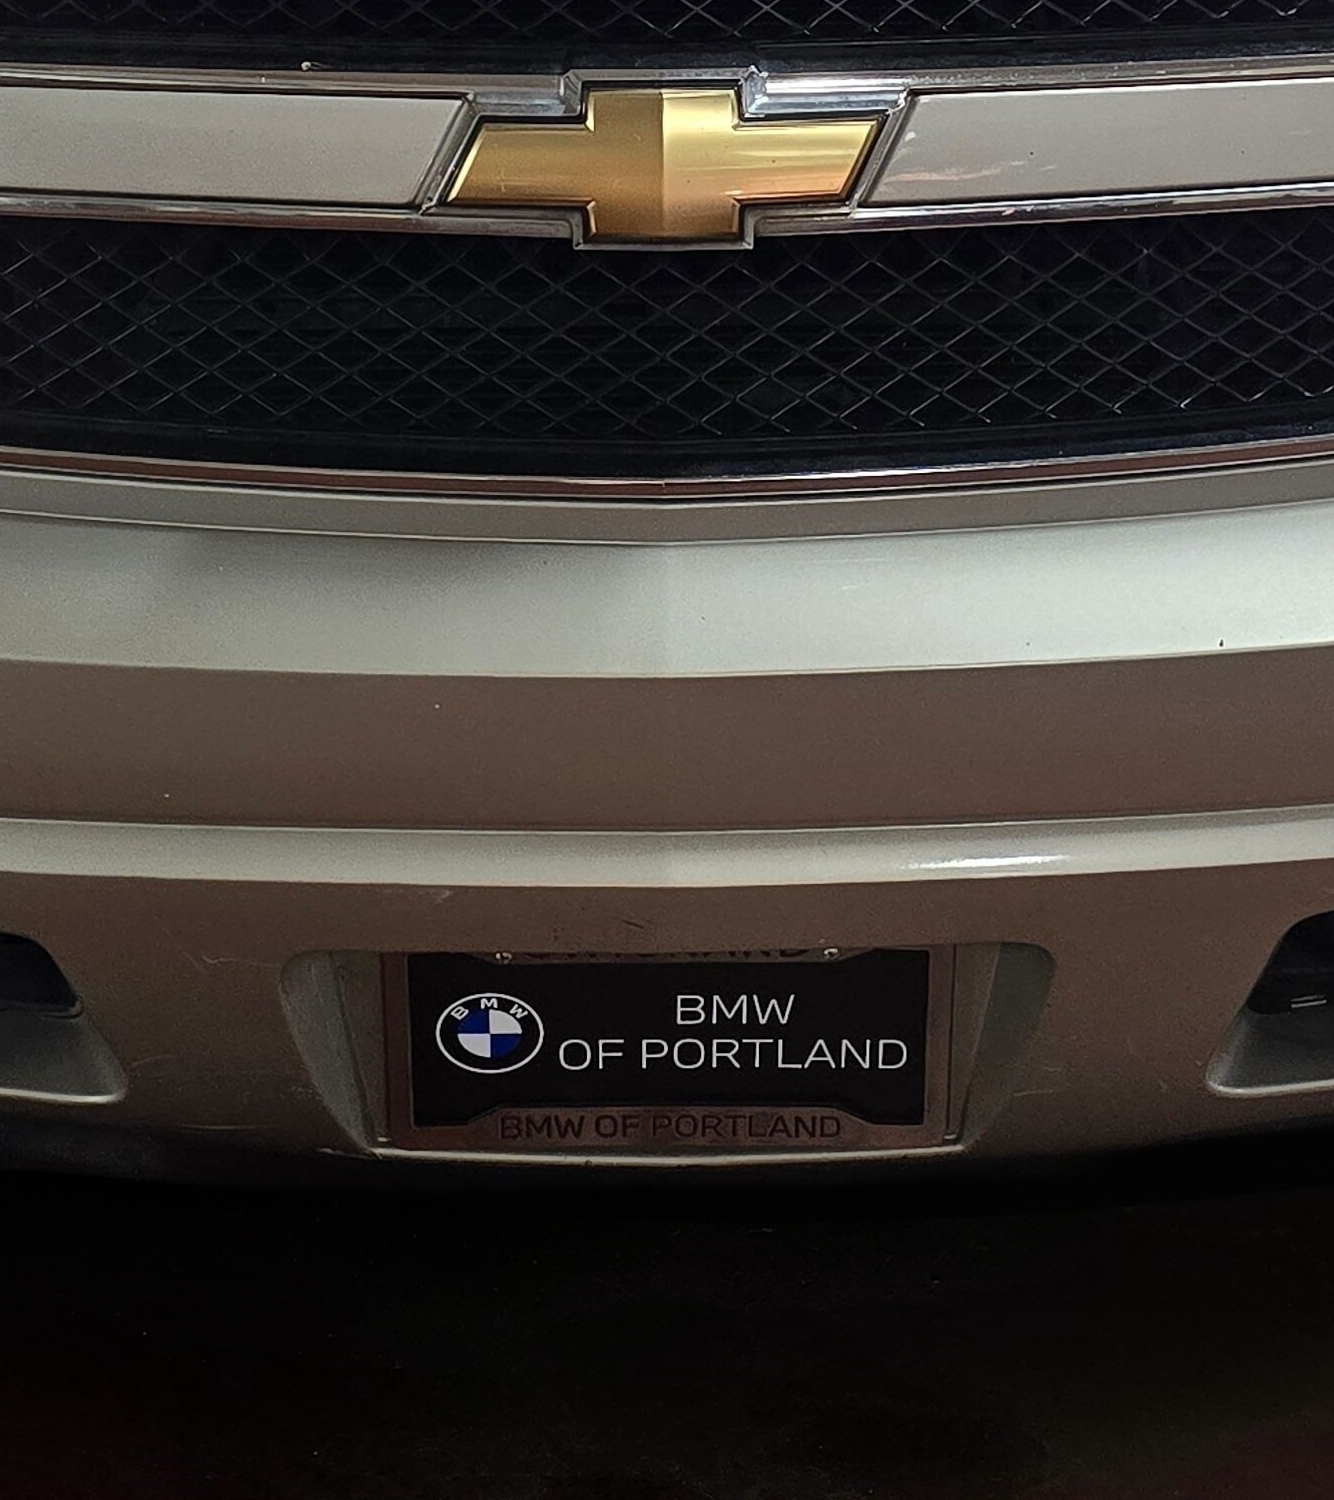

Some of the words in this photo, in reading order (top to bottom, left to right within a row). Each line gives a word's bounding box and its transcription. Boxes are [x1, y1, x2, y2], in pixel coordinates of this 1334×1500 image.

[450, 997, 529, 1021] BMW
[675, 994, 795, 1025] BMW
[558, 1039, 625, 1070] OF
[641, 1038, 907, 1070] PORTLAND
[500, 1113, 586, 1140] BMW
[594, 1113, 643, 1139] OF
[652, 1113, 842, 1139] PORTLAND
